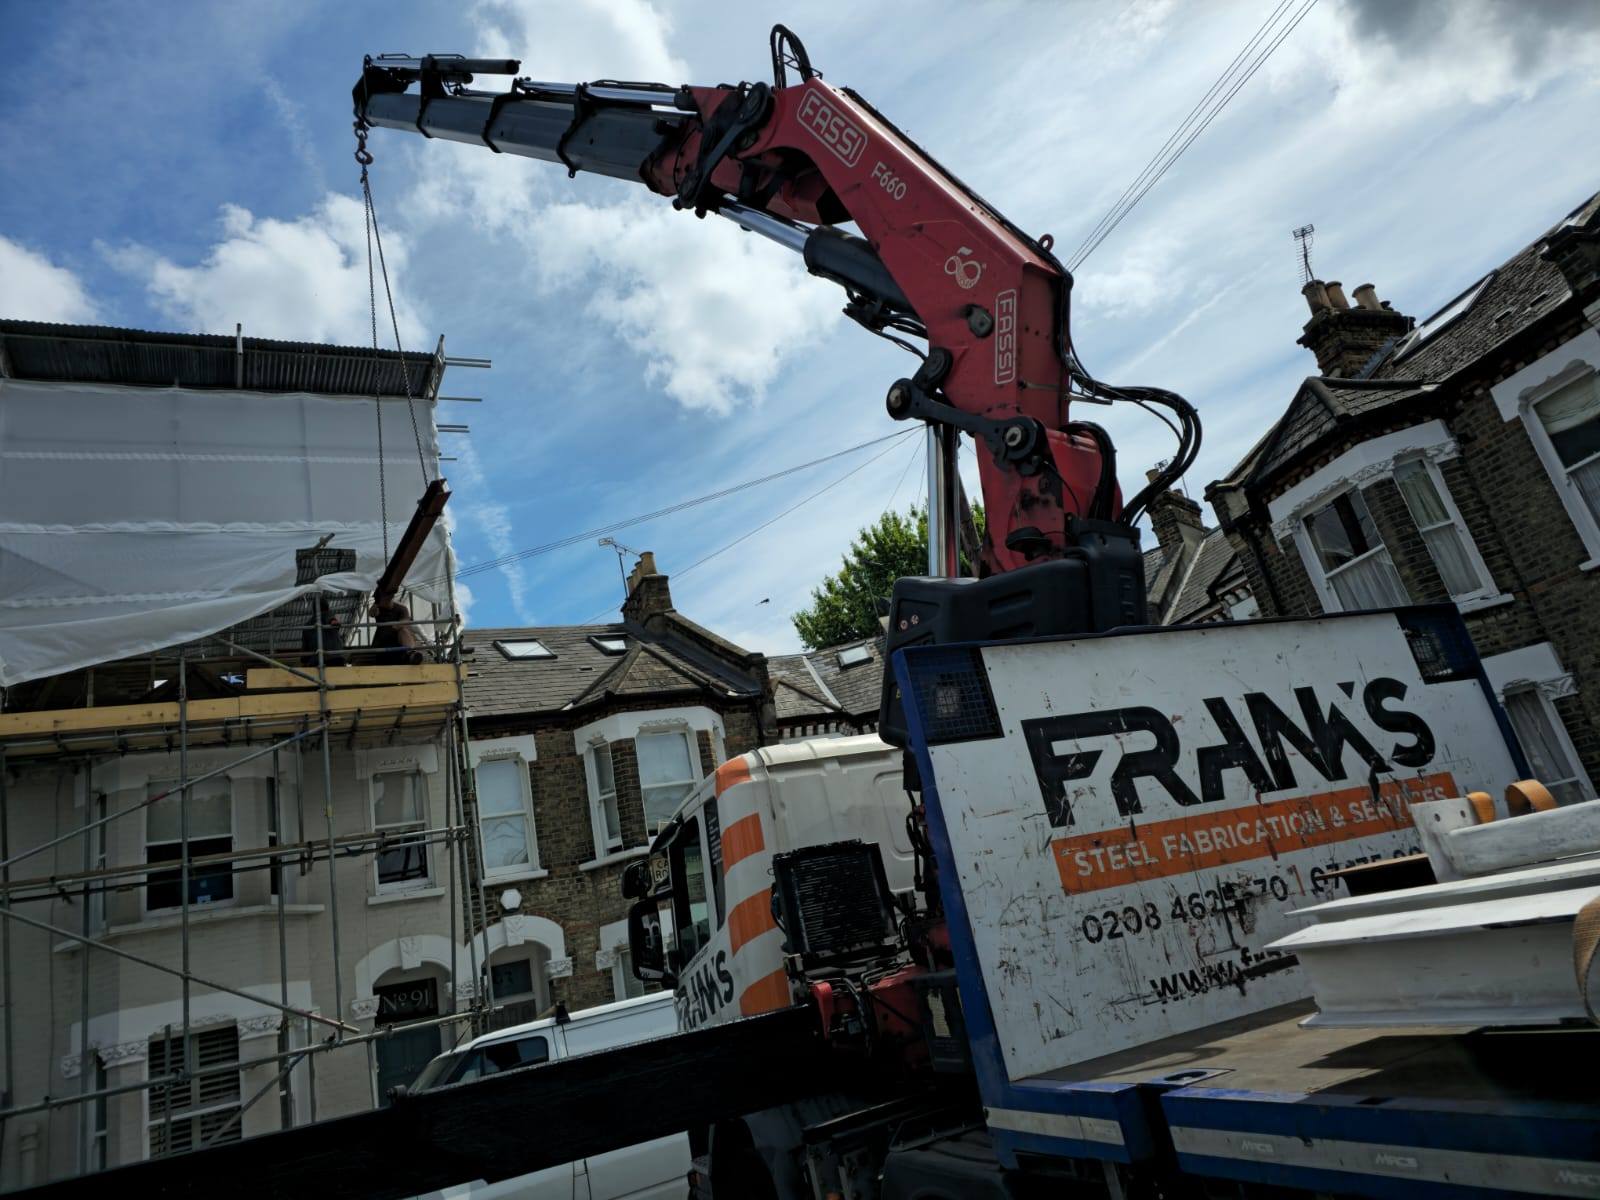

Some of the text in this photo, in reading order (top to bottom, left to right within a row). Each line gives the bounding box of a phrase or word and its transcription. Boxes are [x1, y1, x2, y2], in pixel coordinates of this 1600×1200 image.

[801, 97, 864, 159] FASSI
[871, 161, 908, 200] F660
[998, 297, 1014, 377] FASSI
[1020, 676, 1437, 828] FRANK'S
[1073, 840, 1159, 877] STEEL
[1161, 811, 1321, 859] FABRICATION
[1328, 804, 1347, 828] &
[1081, 902, 1162, 944] 0208
